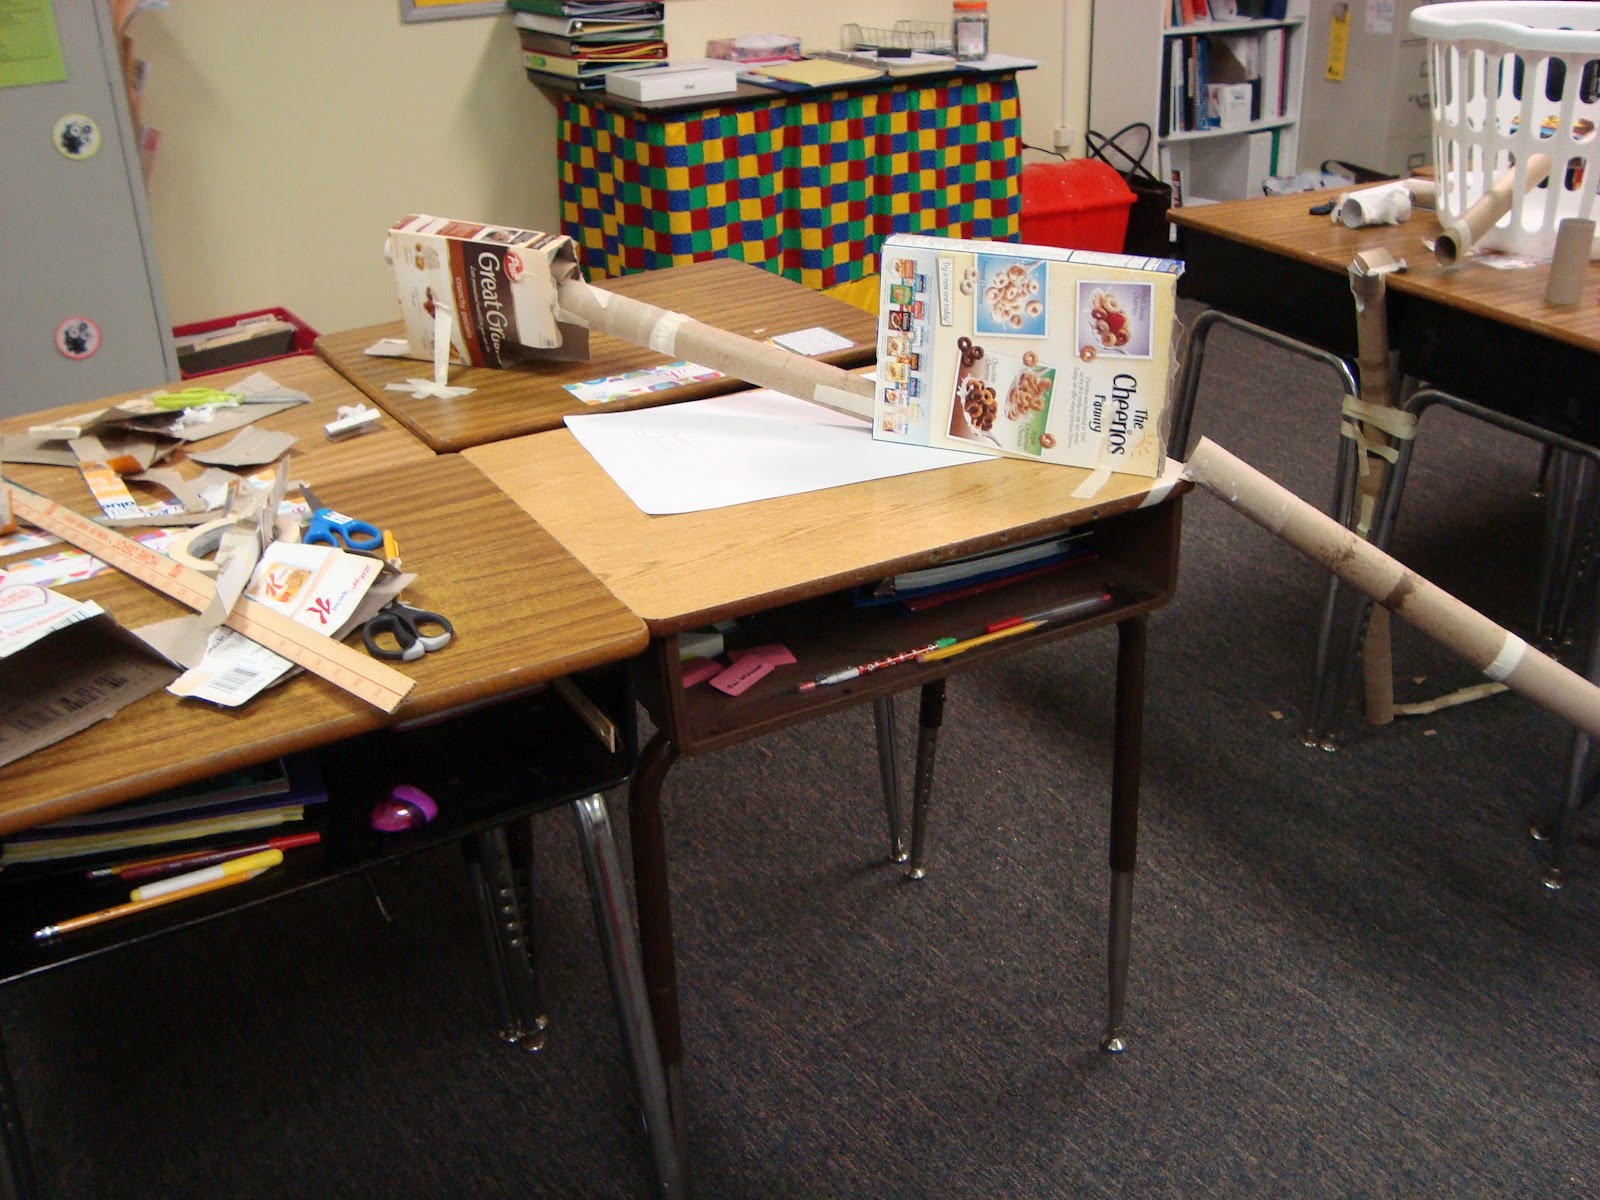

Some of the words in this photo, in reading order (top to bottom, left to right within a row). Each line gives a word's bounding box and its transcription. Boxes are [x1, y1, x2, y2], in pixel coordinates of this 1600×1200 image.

[478, 251, 503, 309] Great
[485, 309, 508, 364] Gra
[1107, 373, 1137, 455] Cheerios
[1133, 408, 1149, 430] The
[305, 597, 331, 625] K
